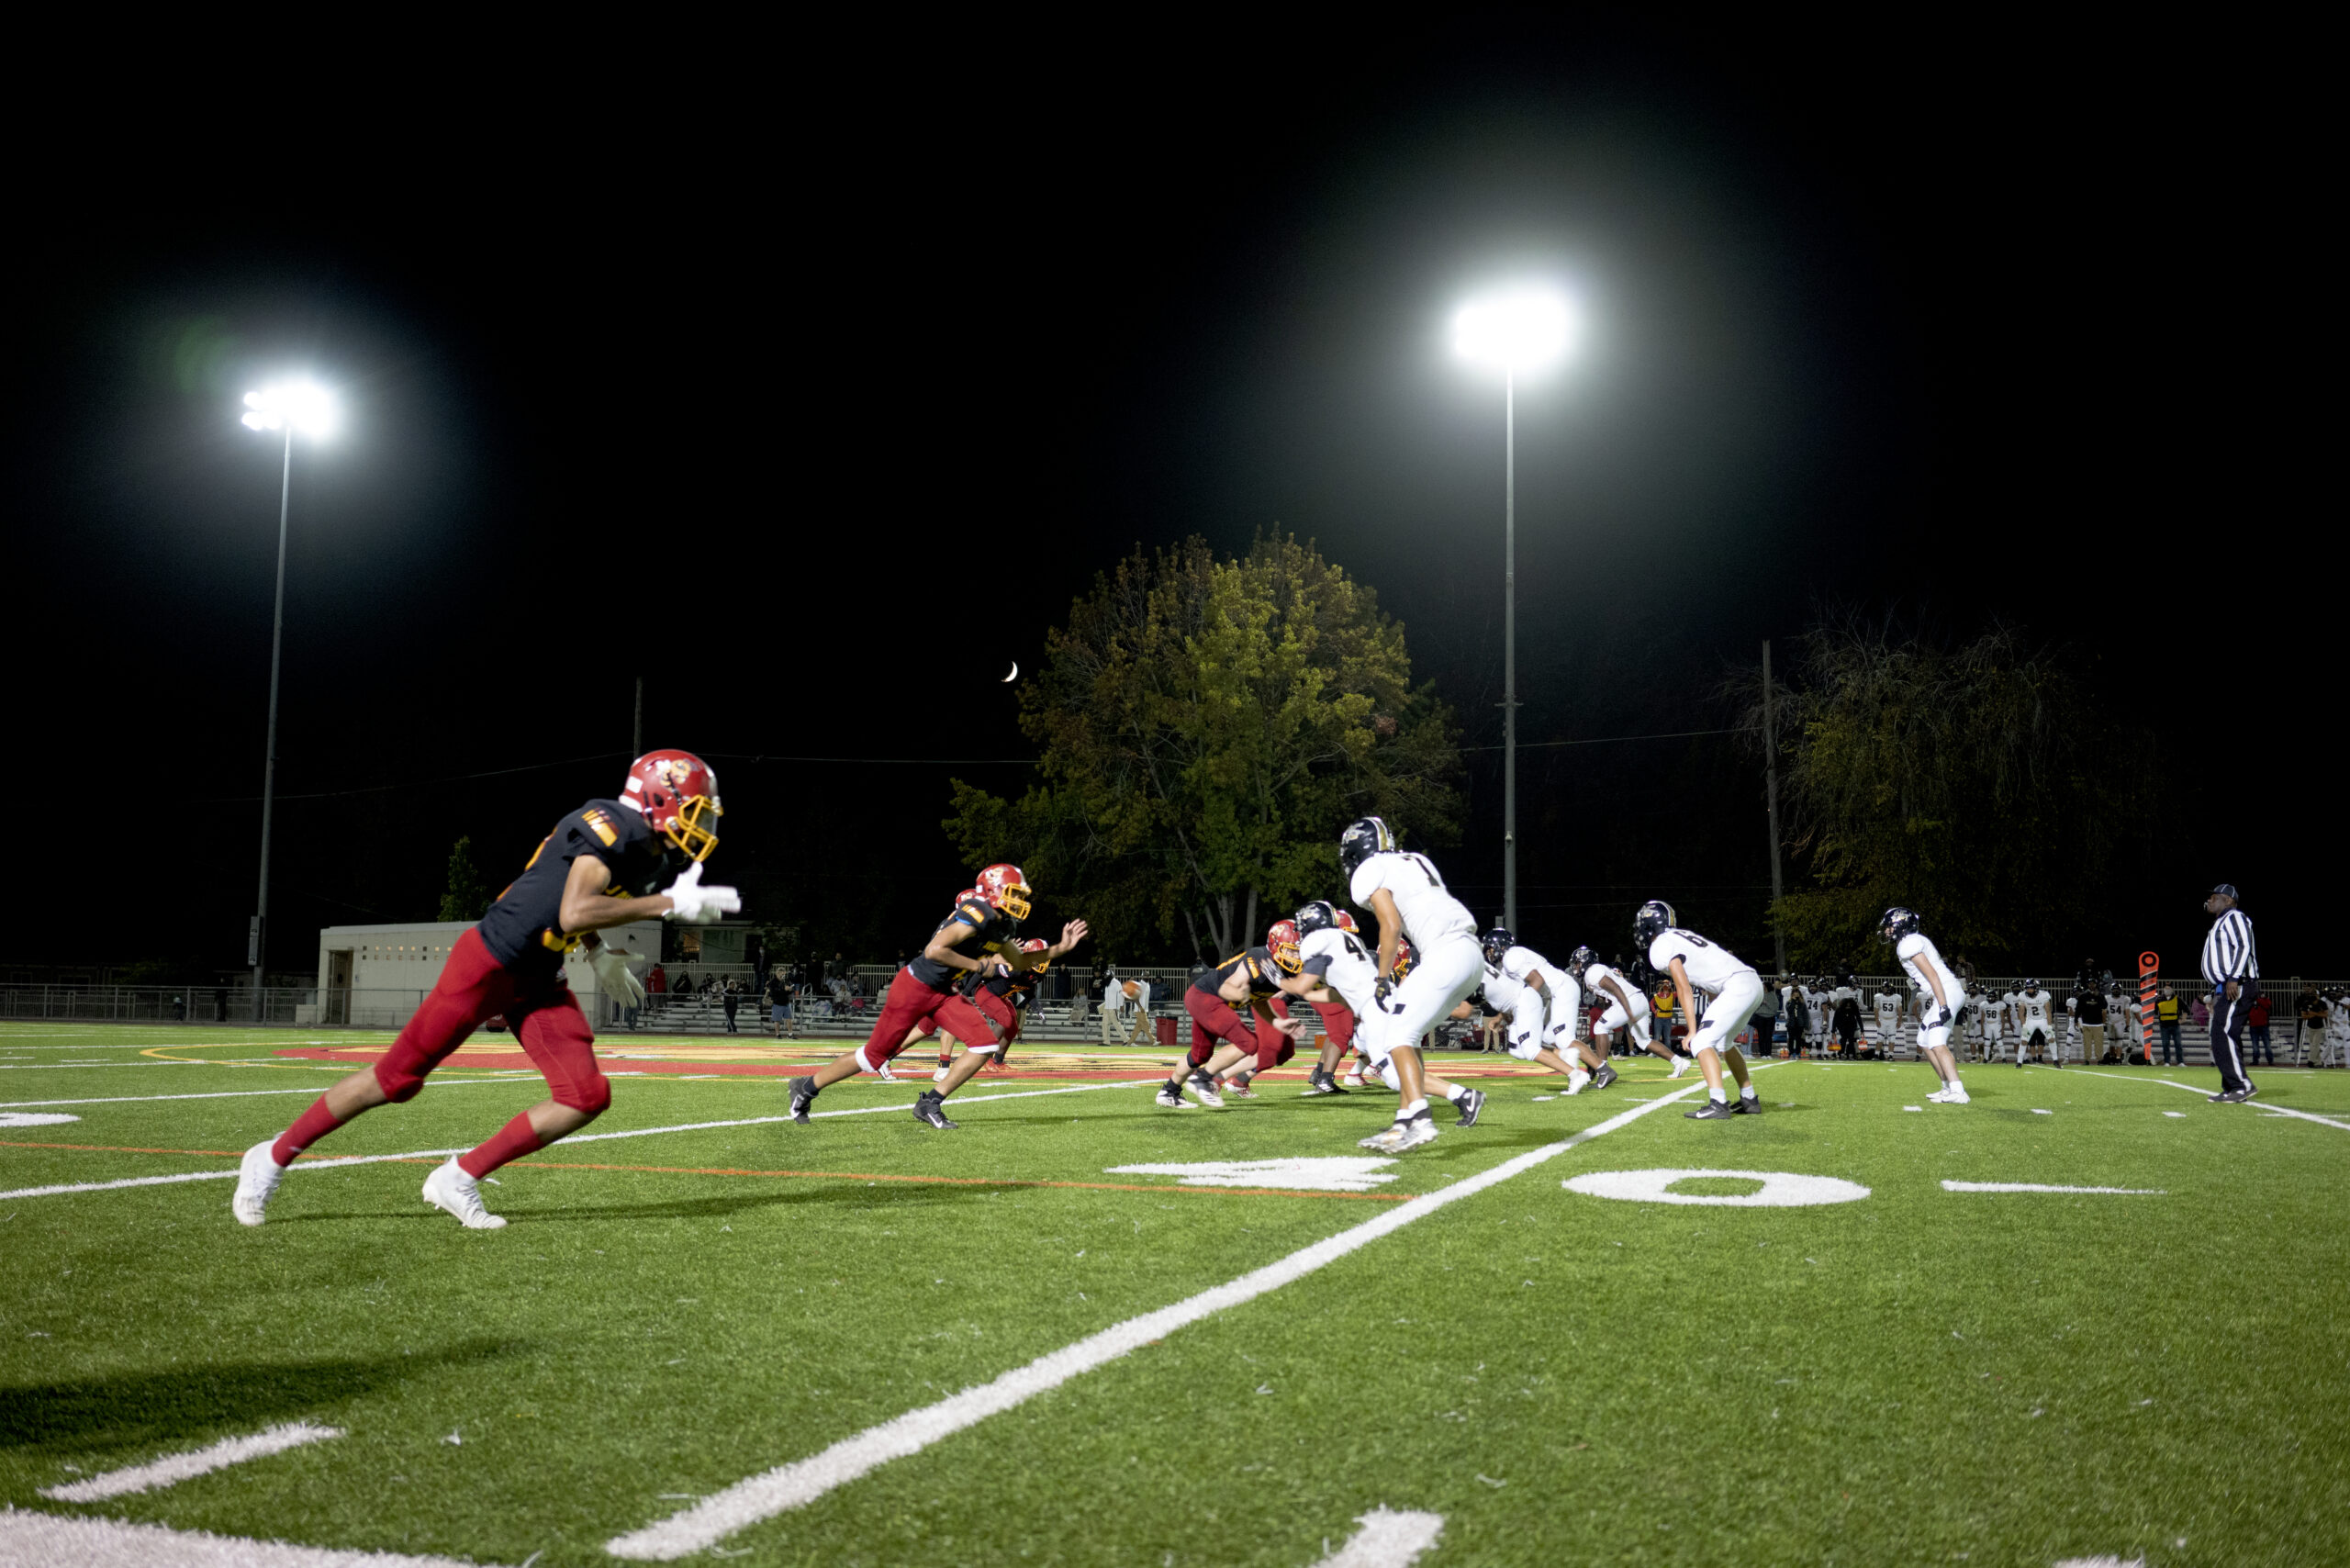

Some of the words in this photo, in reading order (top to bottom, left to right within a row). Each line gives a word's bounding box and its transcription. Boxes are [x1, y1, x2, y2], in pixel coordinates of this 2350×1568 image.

[1343, 935, 1366, 961] 4
[2031, 1006, 2040, 1016] 2
[2109, 1004, 2121, 1014] 54
